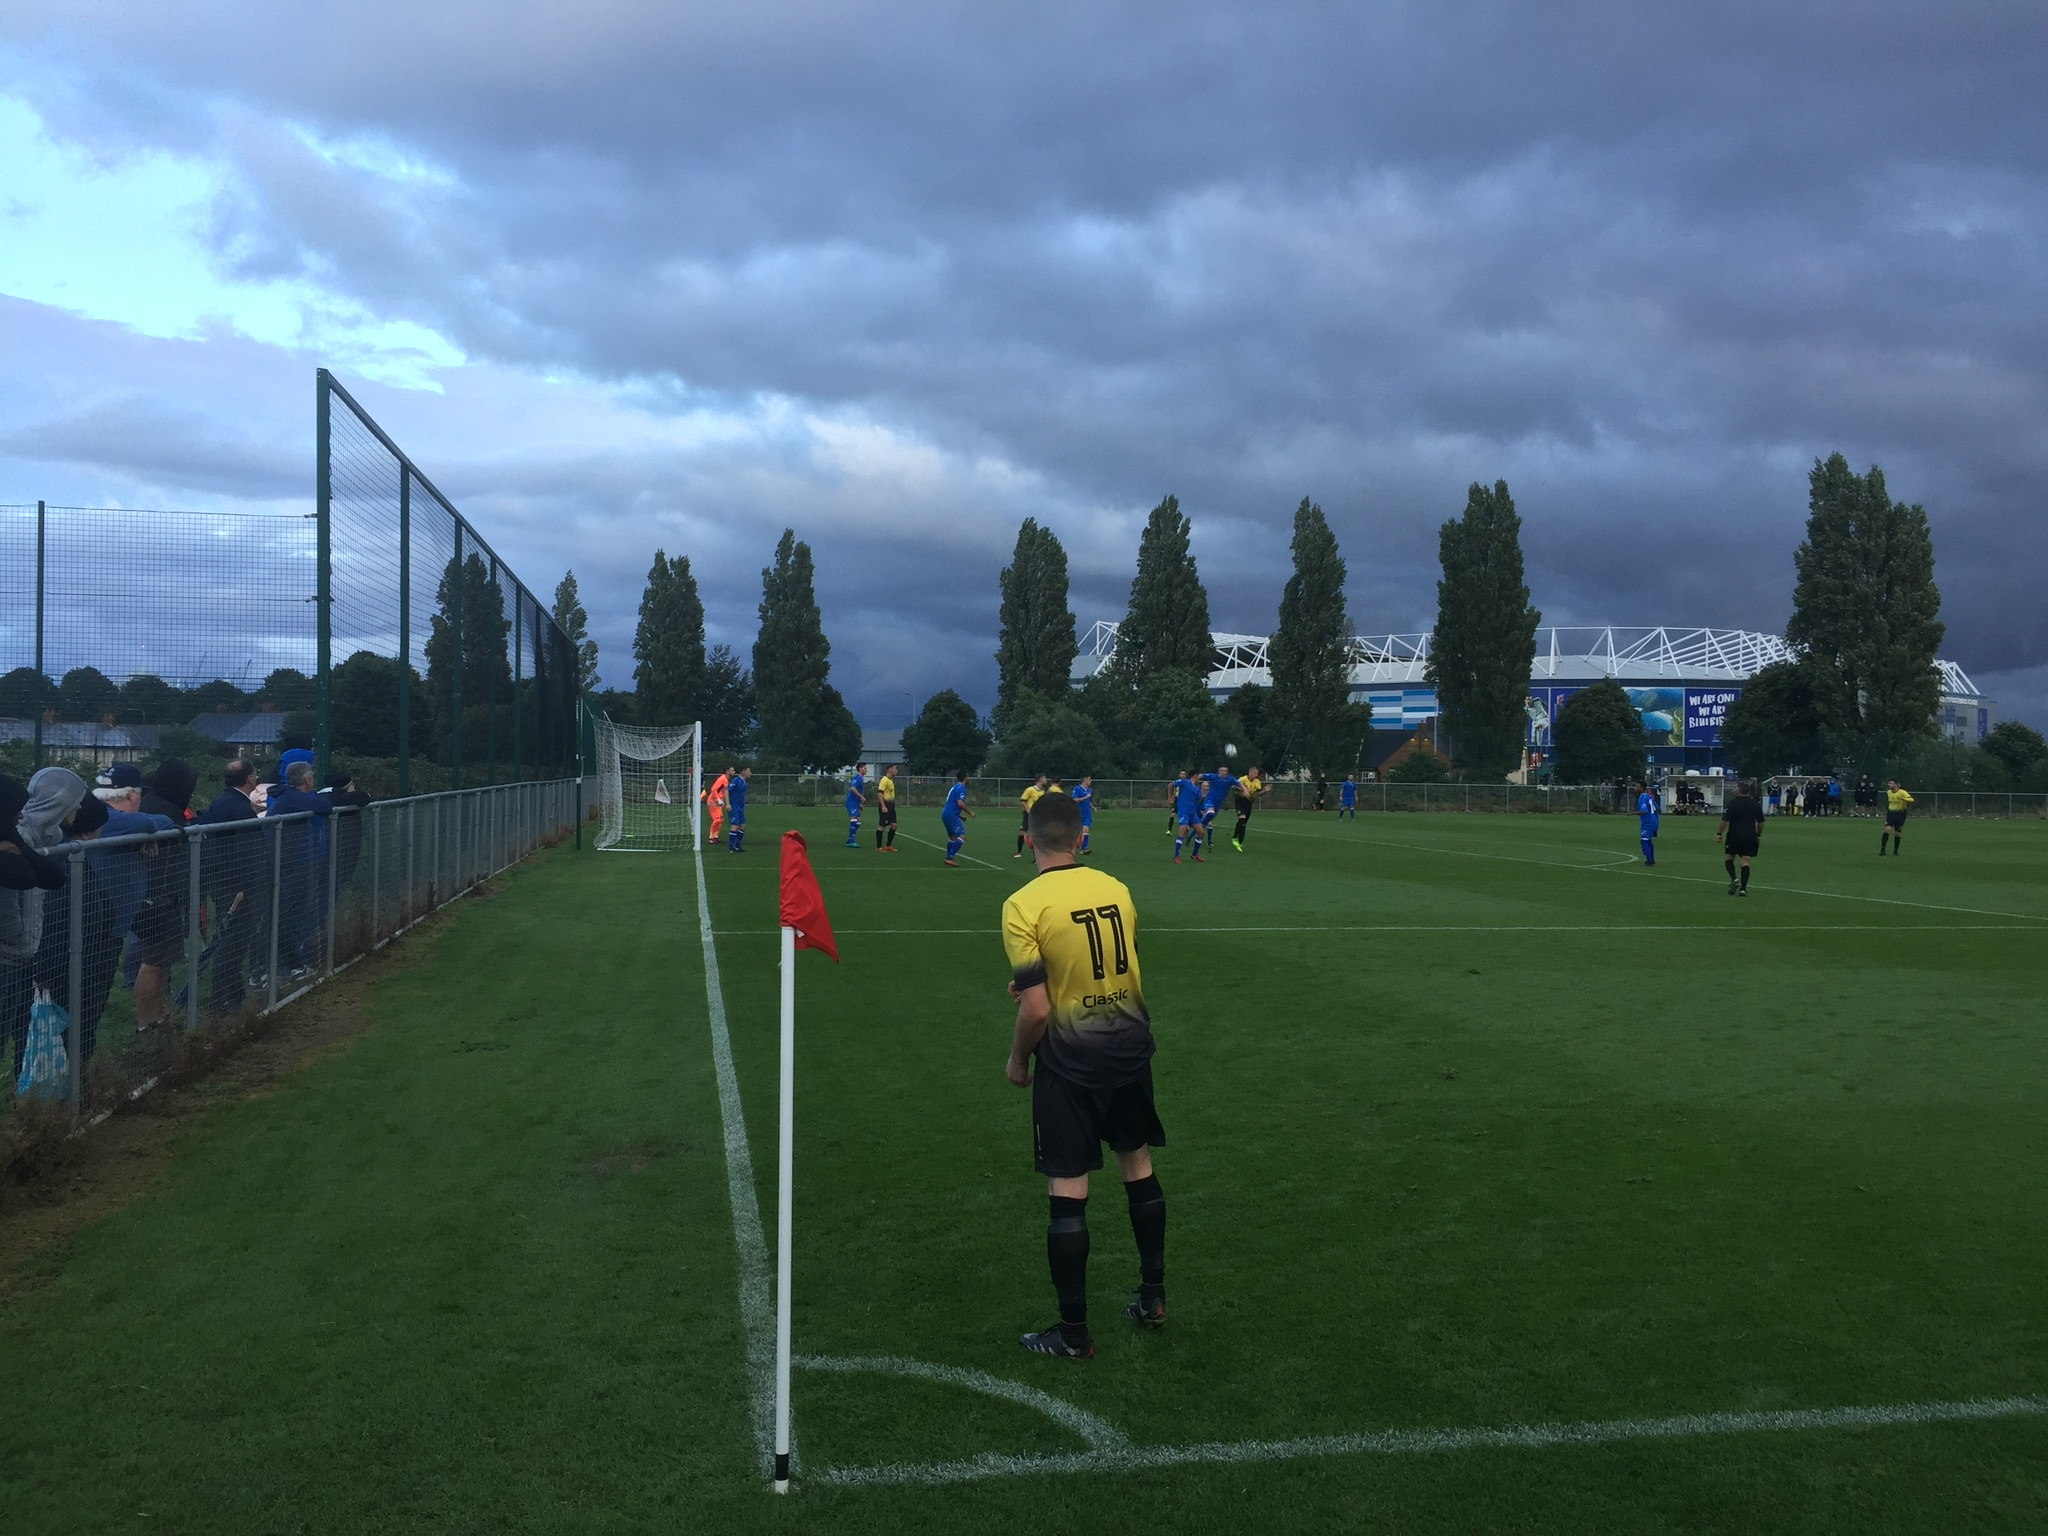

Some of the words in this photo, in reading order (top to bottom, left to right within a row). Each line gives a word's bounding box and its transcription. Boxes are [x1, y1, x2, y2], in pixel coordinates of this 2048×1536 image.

[1689, 695, 1701, 706] WE
[1702, 694, 1717, 705] ARE
[1698, 706, 1711, 716] WE
[1070, 904, 1129, 981] 11
[1082, 988, 1129, 1009] Classic
